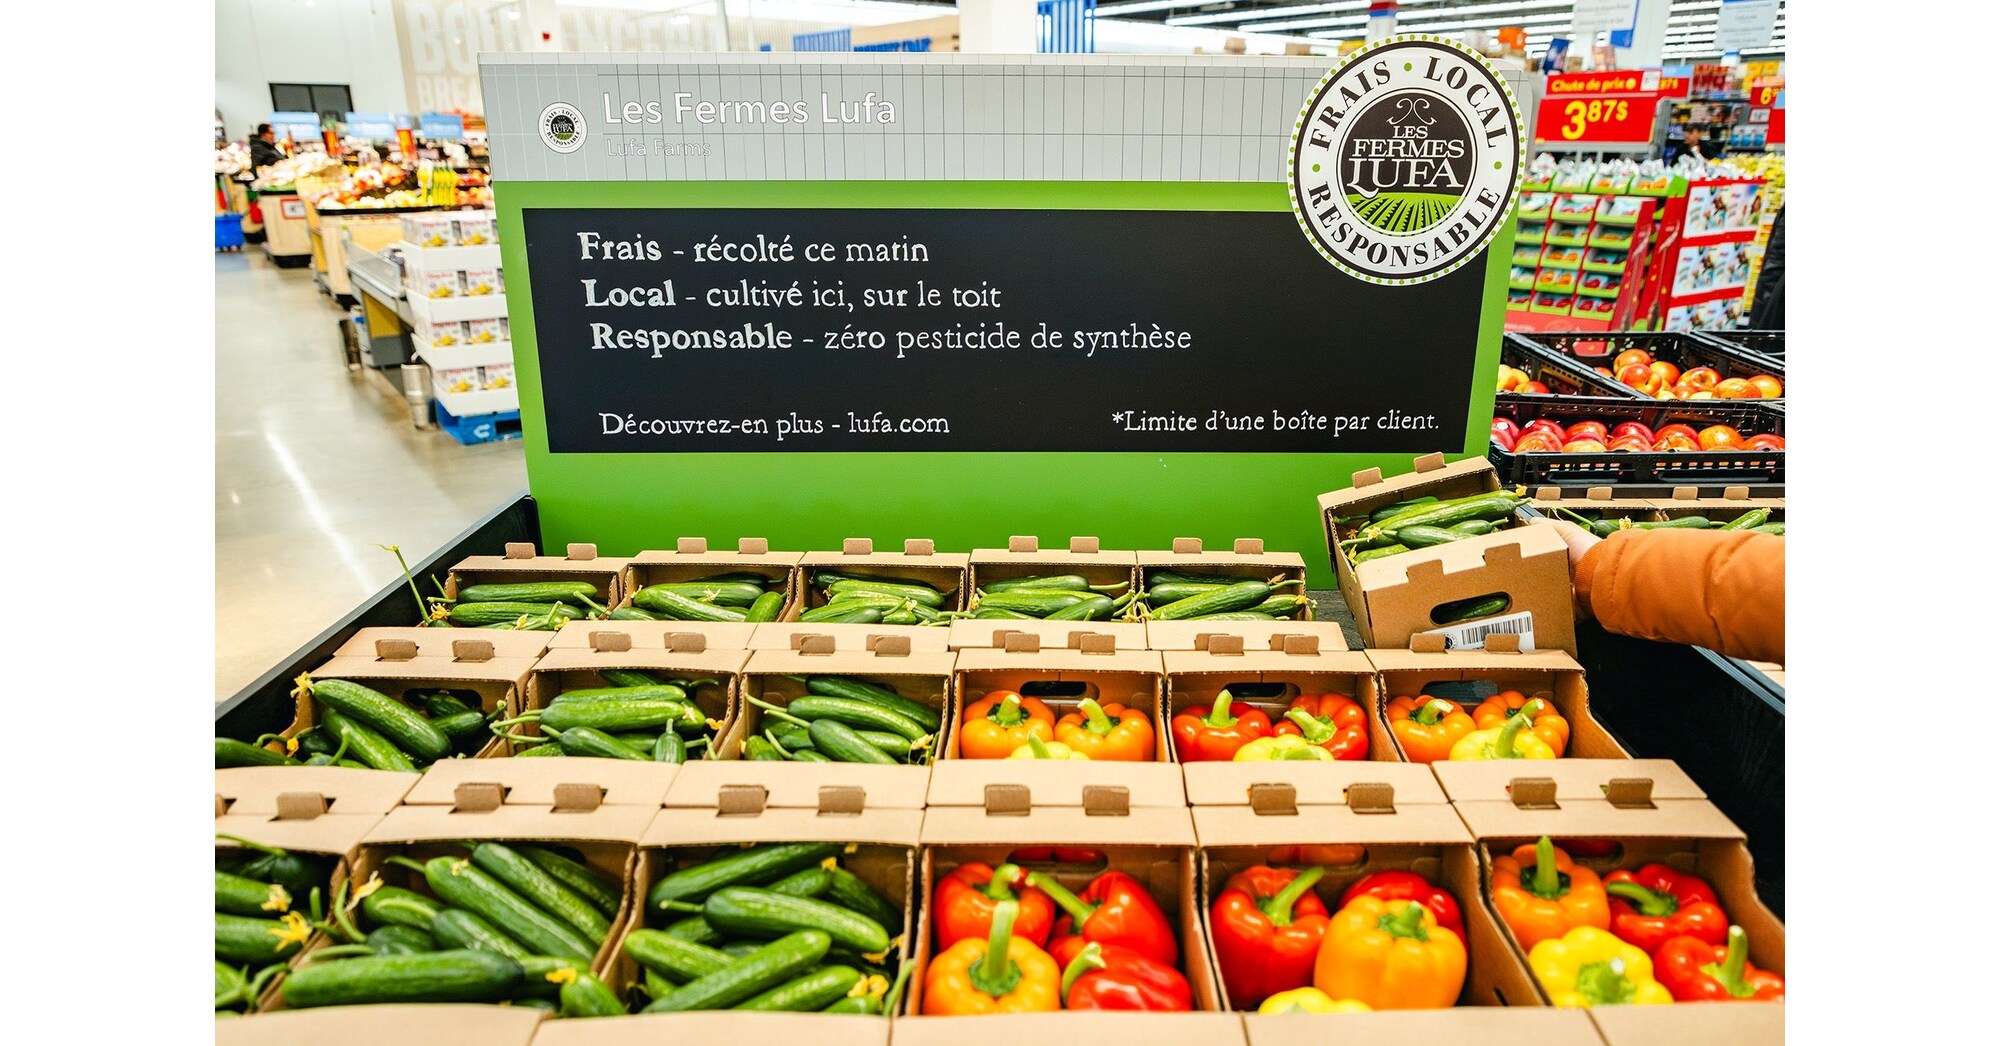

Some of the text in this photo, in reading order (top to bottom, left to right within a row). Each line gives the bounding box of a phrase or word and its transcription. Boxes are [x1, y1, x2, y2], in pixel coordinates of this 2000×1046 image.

[1551, 76, 1626, 93] Chute de prix
[603, 91, 896, 124] Les Fermes Lufa
[1308, 55, 1508, 152] FRAIS LOCAL
[606, 138, 712, 157] Lufa Farms
[1392, 125, 1429, 139] LES
[1351, 138, 1466, 159] FERMES
[1346, 157, 1465, 200] LUFA
[1307, 181, 1501, 267] RESPONSABLE
[576, 231, 663, 262] Frais
[693, 233, 795, 263] récolté
[804, 242, 836, 262] ce
[845, 234, 929, 263] matin
[580, 278, 677, 307] Local
[706, 278, 803, 308] cultivé
[812, 280, 854, 313] ici,
[863, 288, 909, 308] sur
[917, 279, 942, 308] le
[952, 280, 1002, 308] toit
[589, 322, 793, 359] Responsable
[824, 323, 886, 350] zéro
[895, 321, 1021, 359] pesticide
[1030, 322, 1063, 349] de
[1072, 322, 1192, 358] synthèse
[598, 412, 769, 435] Découvrez-en
[775, 411, 824, 442] plus
[847, 411, 950, 434] lufa.com
[1272, 409, 1328, 431] boîte
[1333, 415, 1371, 438] par
[1376, 408, 1439, 430] client.
